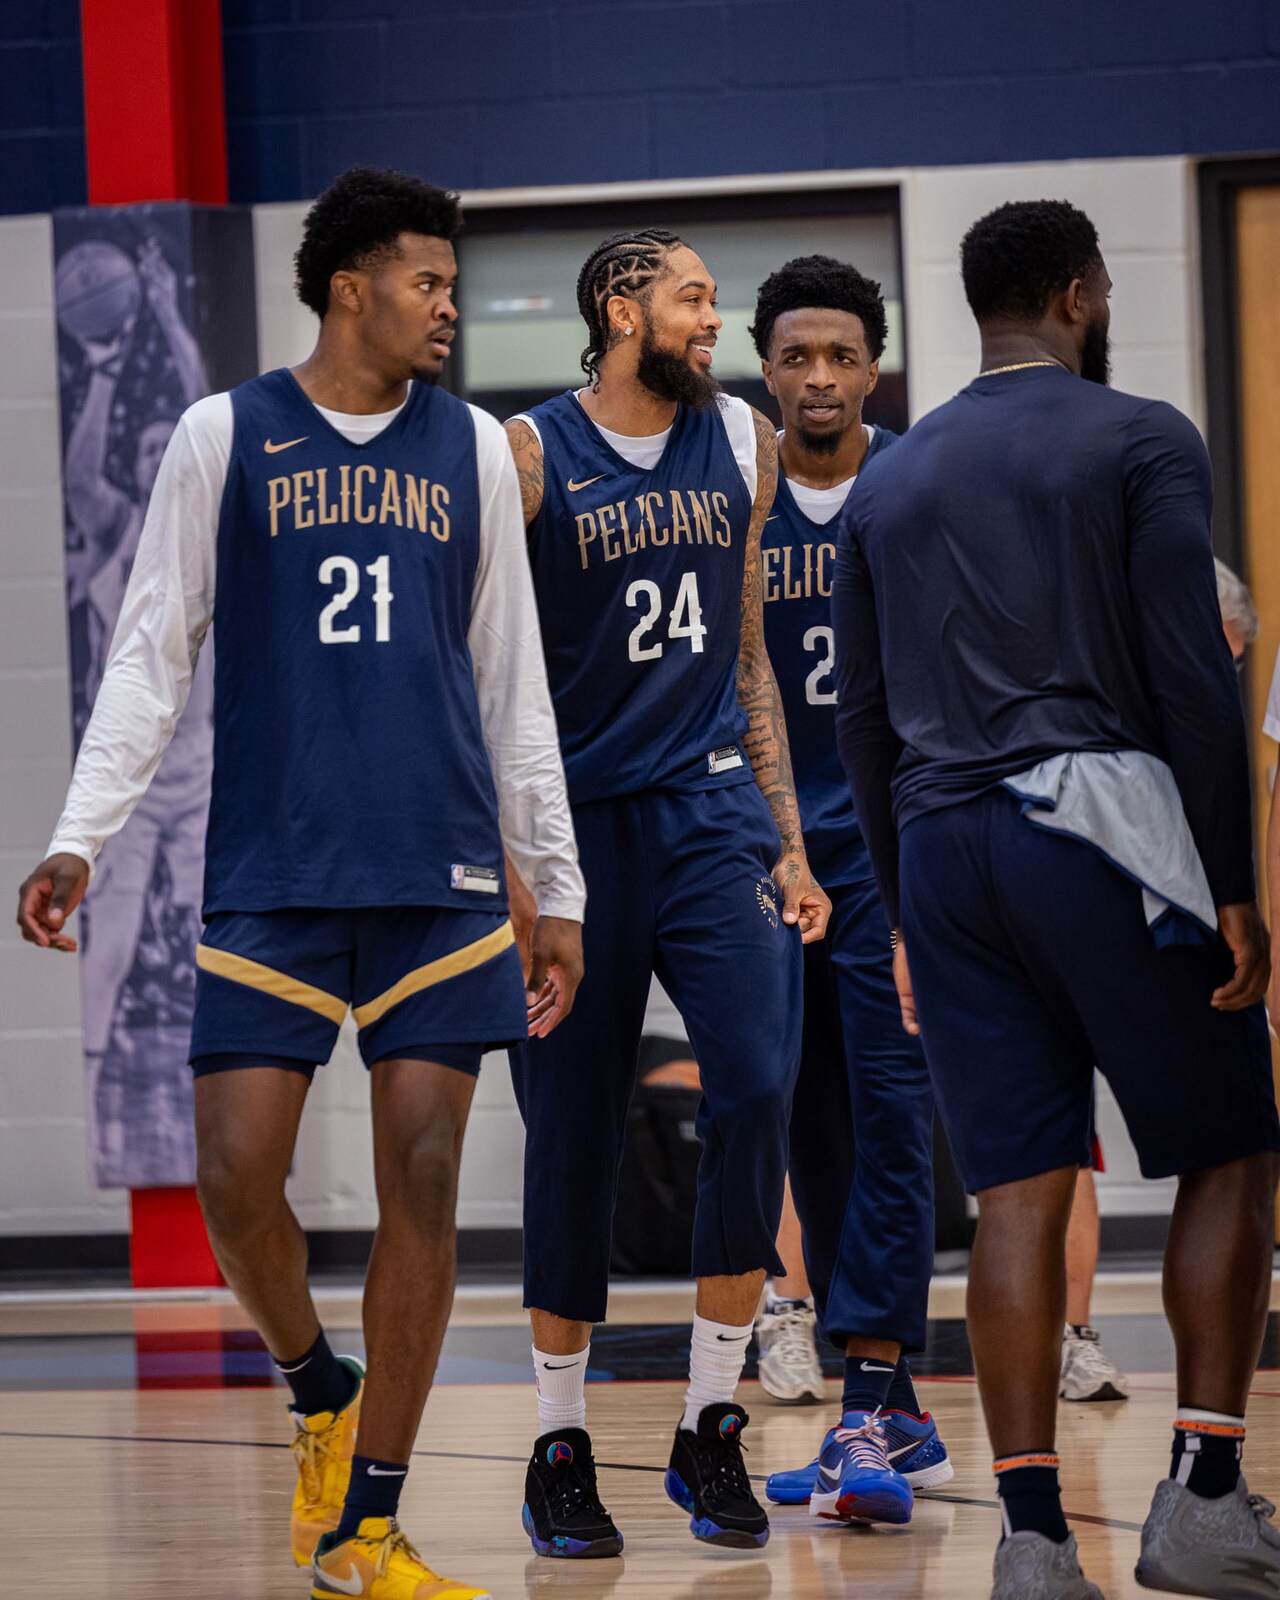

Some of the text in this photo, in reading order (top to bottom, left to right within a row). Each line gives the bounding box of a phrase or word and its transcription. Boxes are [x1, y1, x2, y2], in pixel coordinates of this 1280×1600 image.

[267, 464, 451, 543] PELICANS
[575, 489, 732, 570] PELICANS
[317, 555, 394, 645] 21
[762, 543, 836, 602] ELIC
[625, 571, 708, 663] 24
